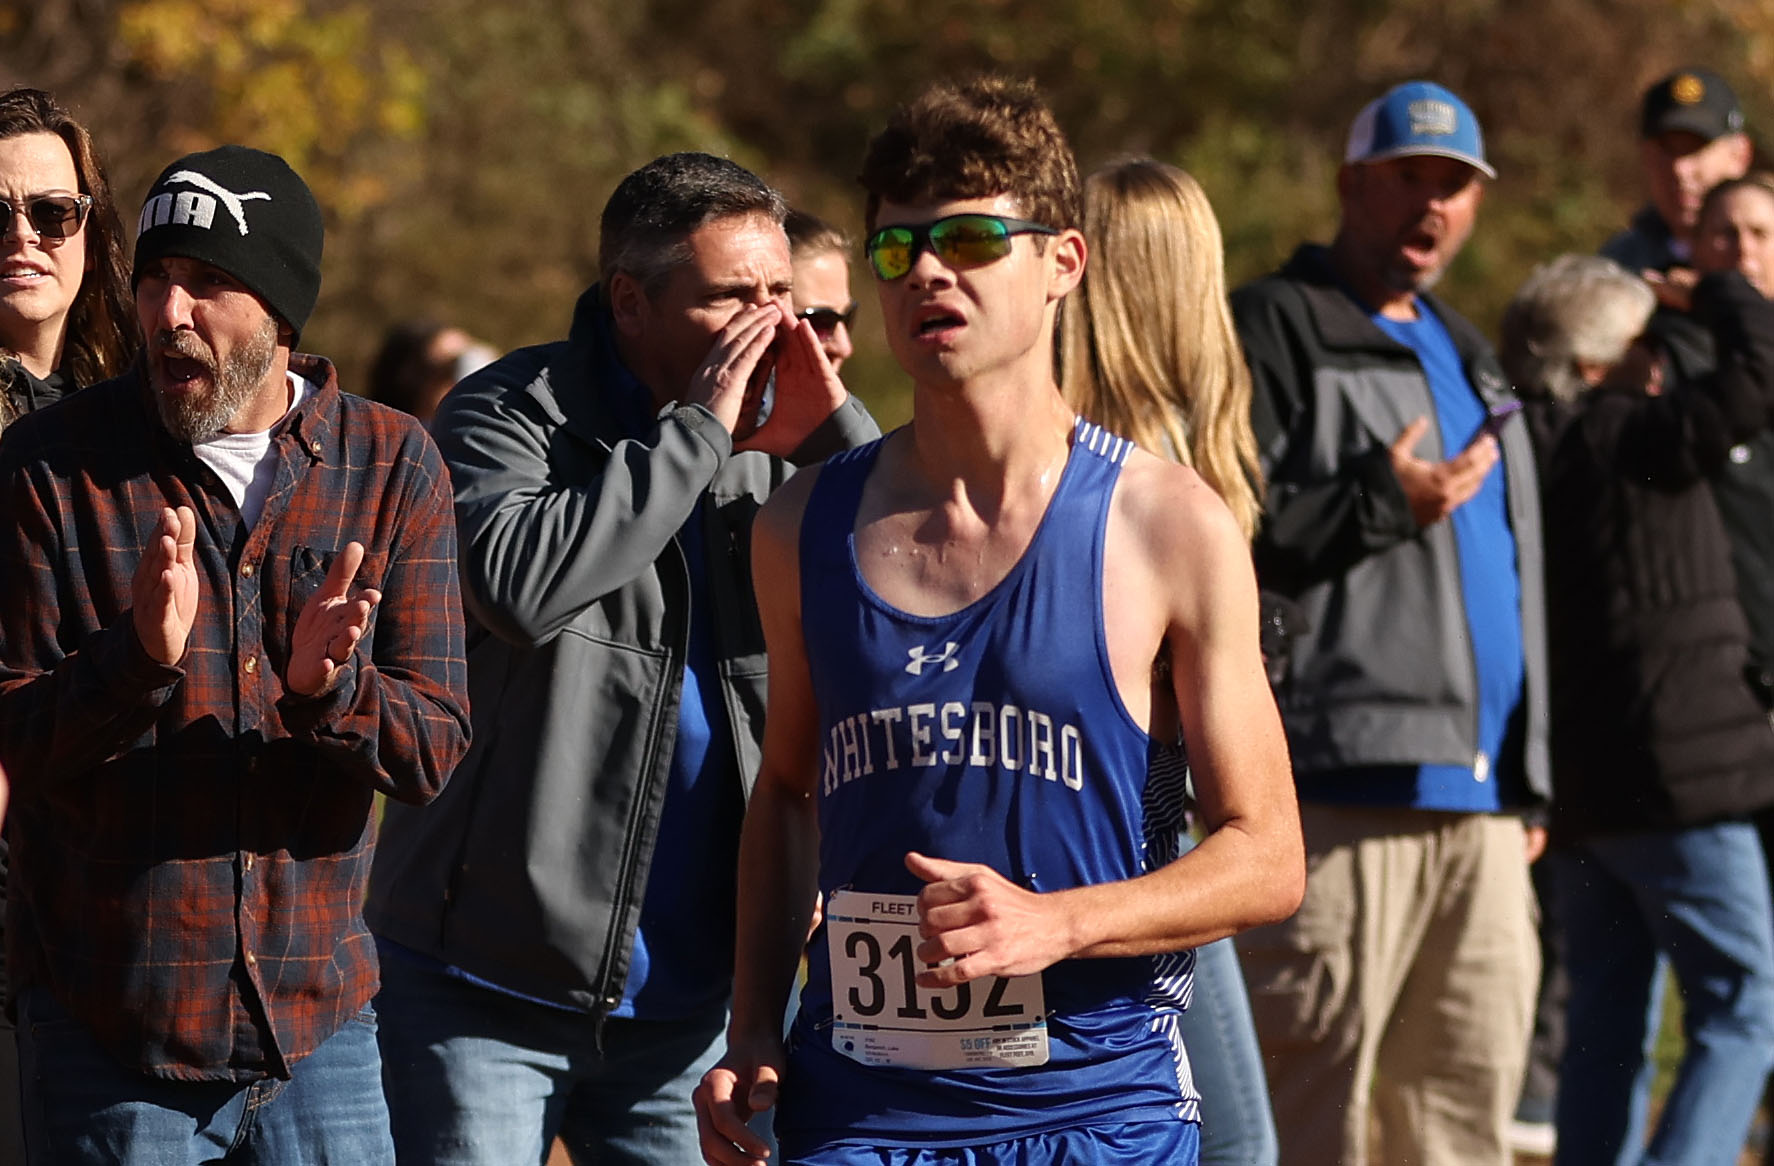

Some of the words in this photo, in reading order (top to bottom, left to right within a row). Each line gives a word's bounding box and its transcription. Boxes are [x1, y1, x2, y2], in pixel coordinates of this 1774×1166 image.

[824, 702, 1083, 798] WHITESBORO
[872, 902, 915, 916] FLEET
[974, 1037, 990, 1050] OFF
